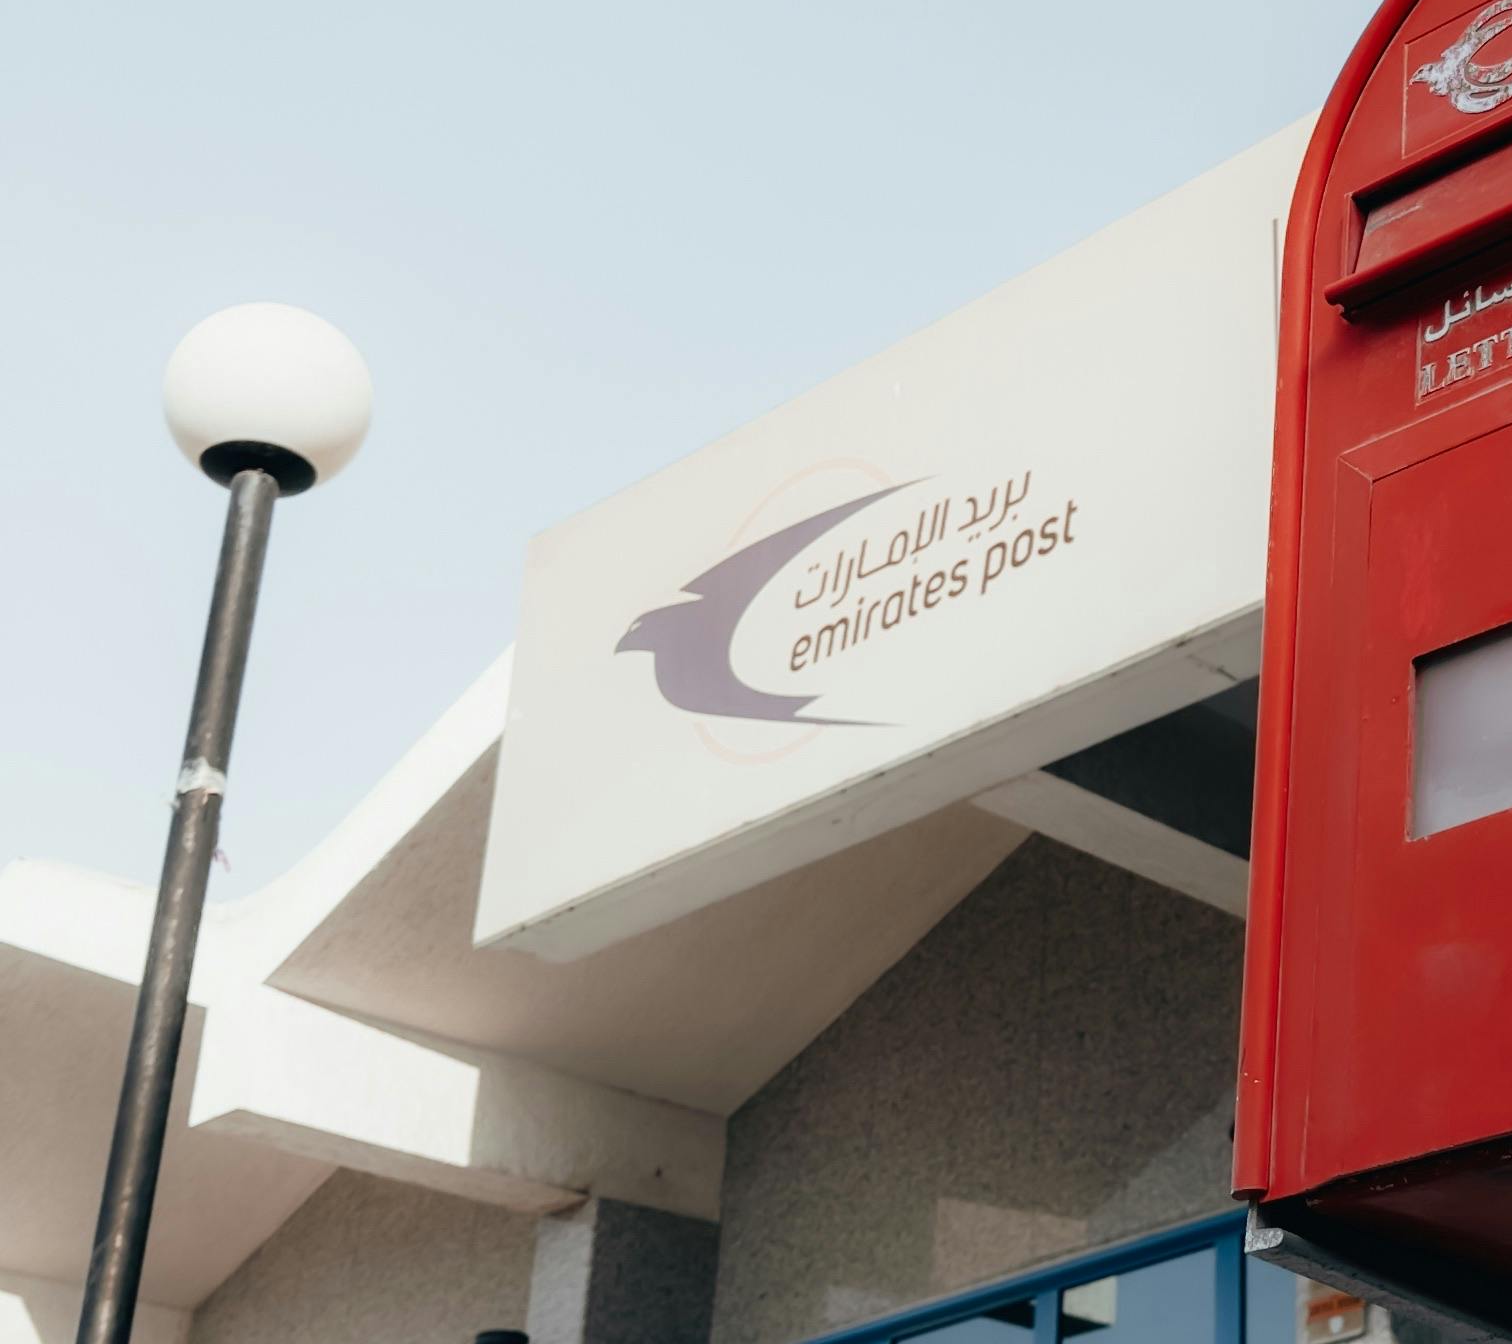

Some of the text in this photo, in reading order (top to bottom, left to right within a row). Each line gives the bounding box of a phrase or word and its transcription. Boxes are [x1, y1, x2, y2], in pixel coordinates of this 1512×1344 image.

[957, 469, 1032, 543] بريد
[789, 498, 1079, 672] emirates post
